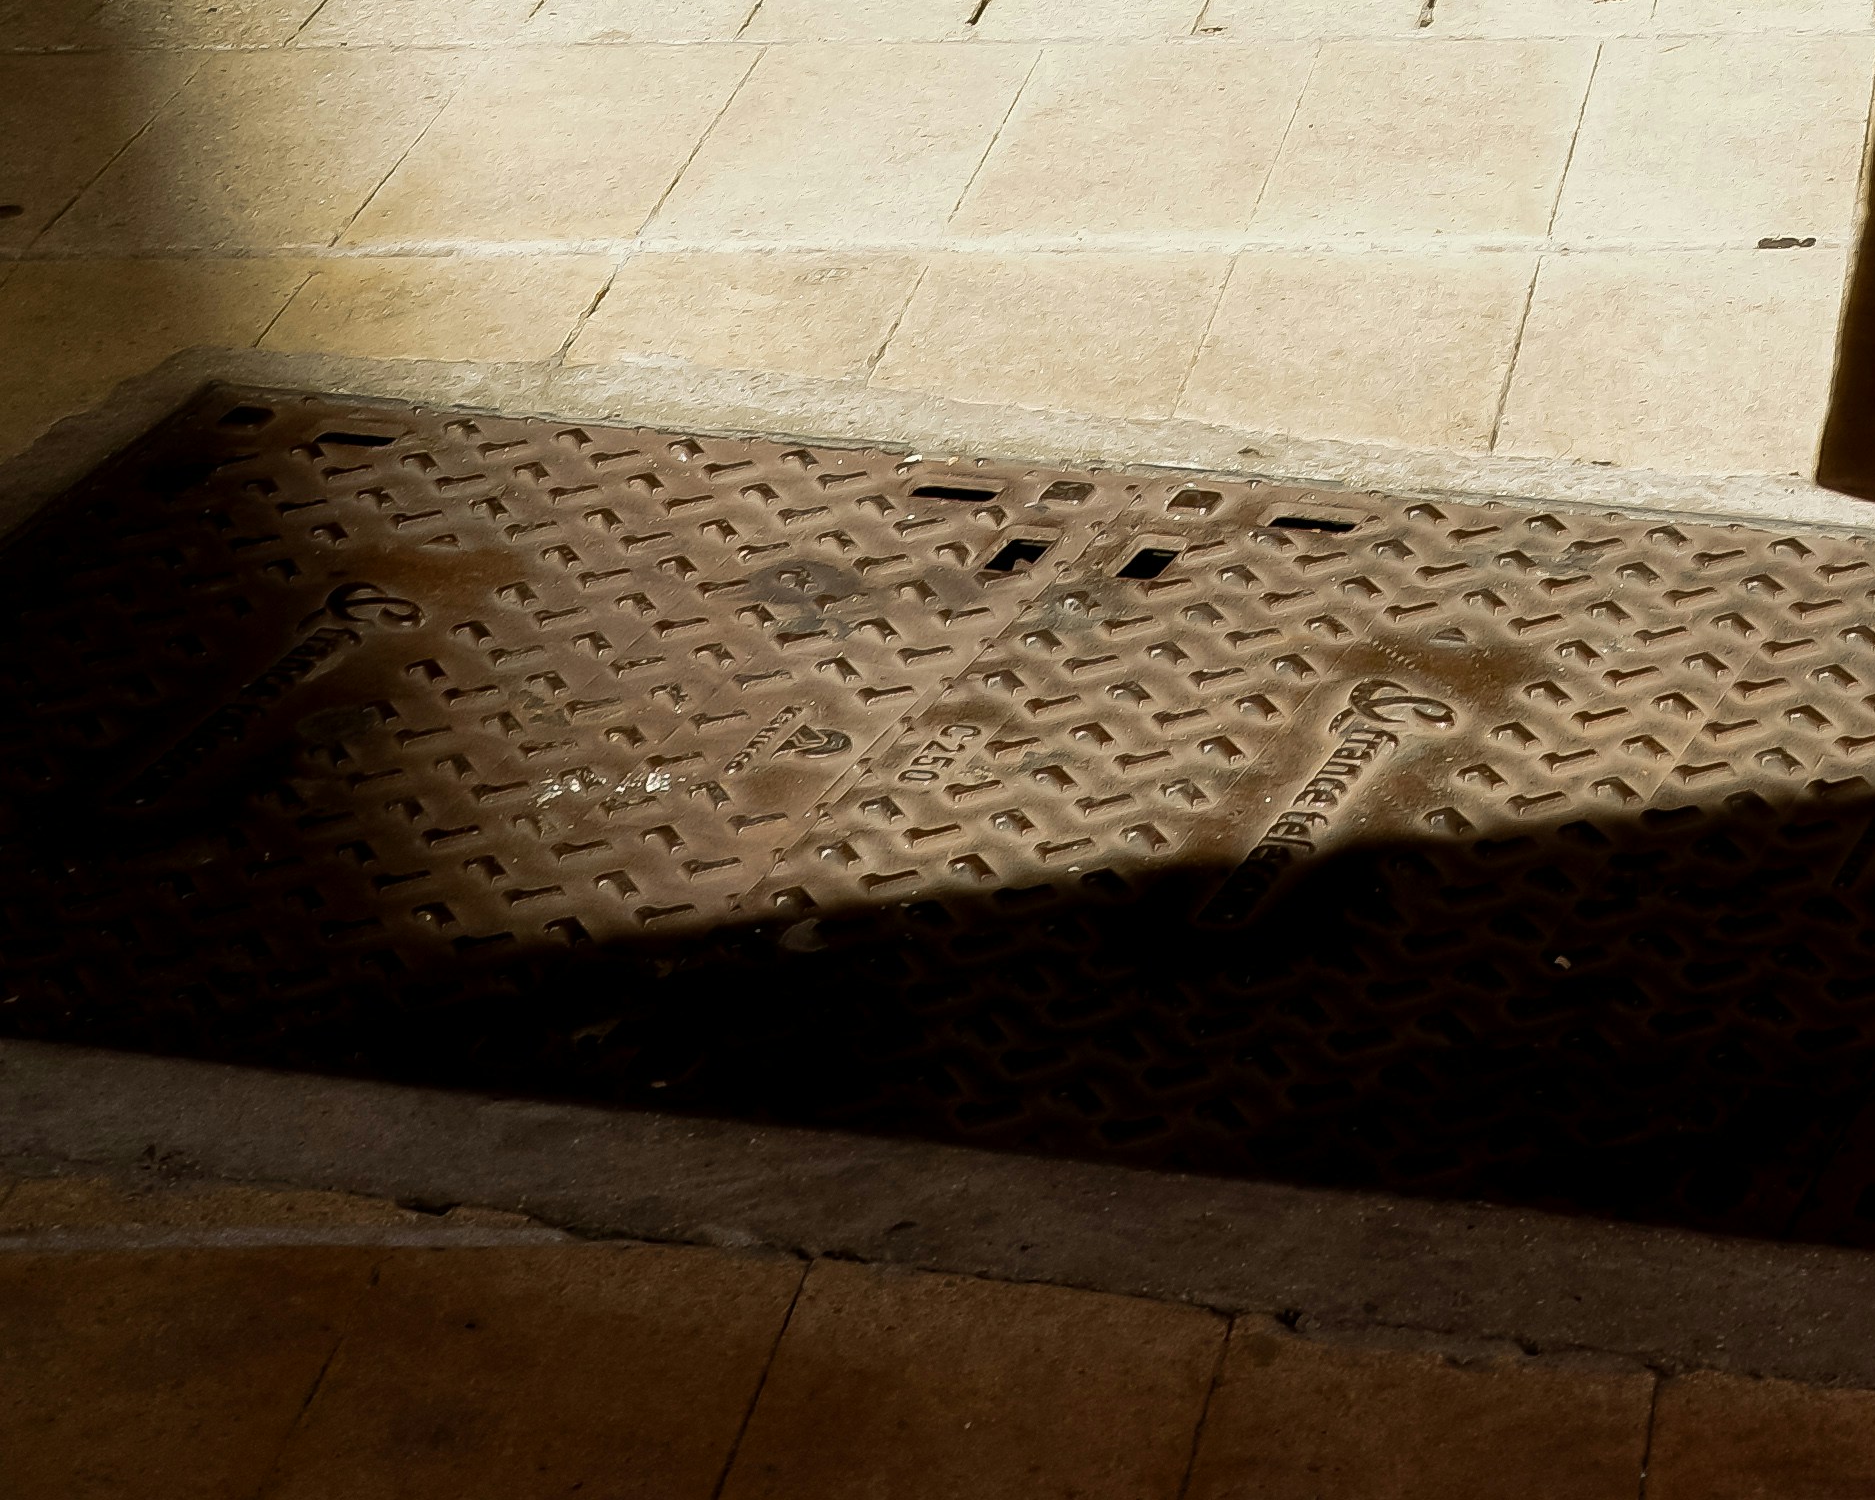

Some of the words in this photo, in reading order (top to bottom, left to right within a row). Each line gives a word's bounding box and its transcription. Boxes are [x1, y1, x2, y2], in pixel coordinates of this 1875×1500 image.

[897, 724, 982, 782] C250
[1291, 729, 1400, 808] france
[1196, 811, 1330, 924] telec
